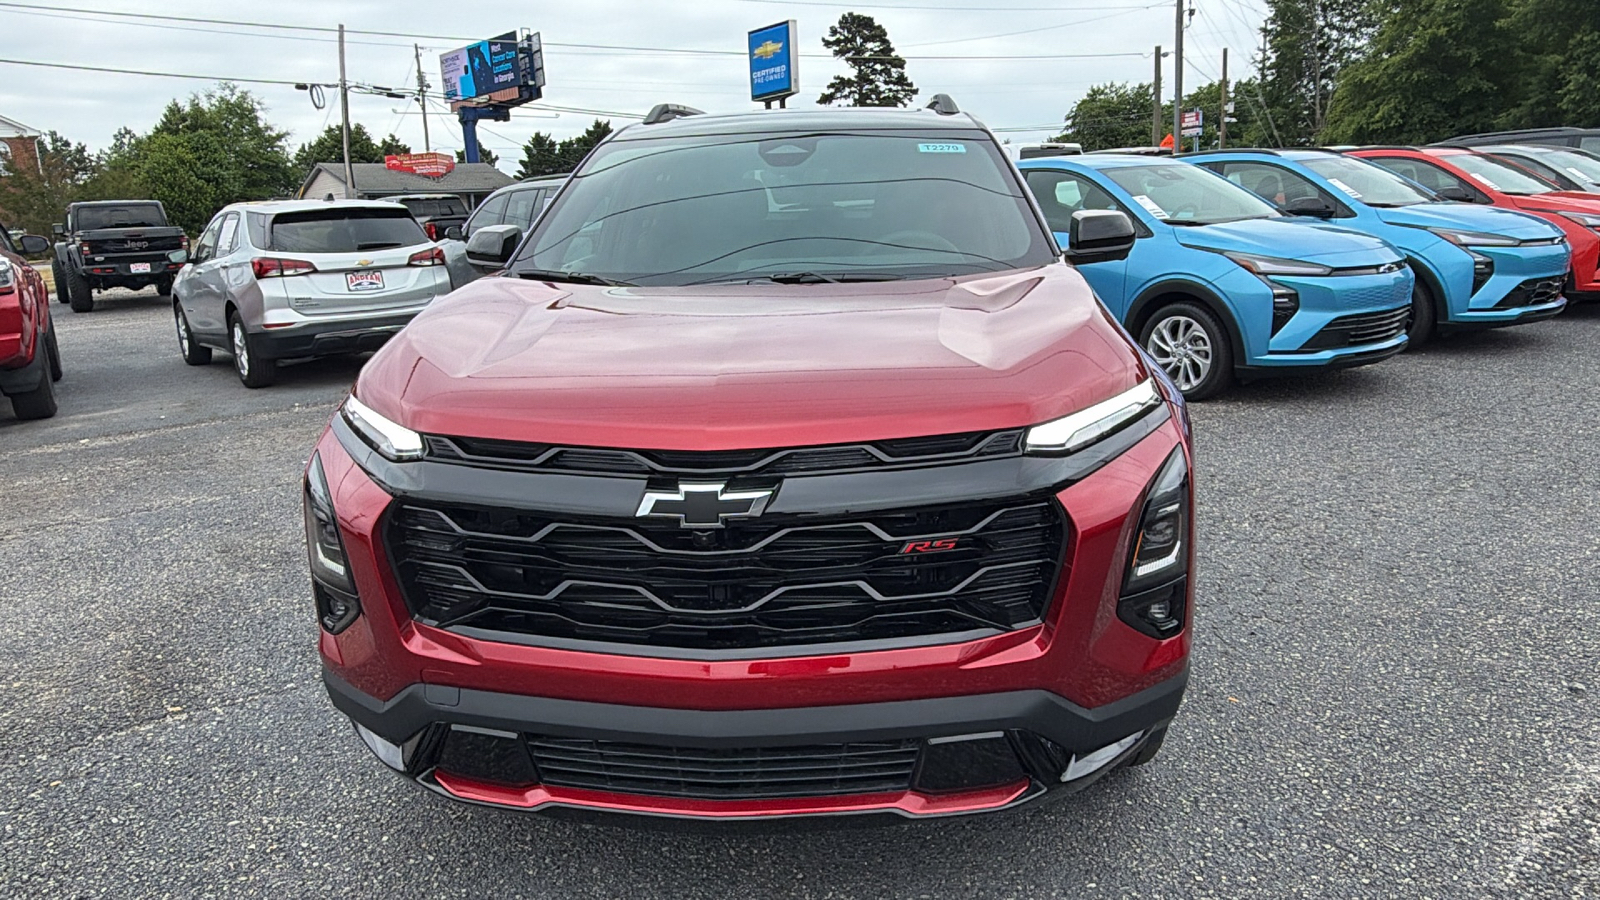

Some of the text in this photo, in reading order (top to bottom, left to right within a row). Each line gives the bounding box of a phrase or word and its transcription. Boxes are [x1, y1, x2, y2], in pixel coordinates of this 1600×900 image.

[492, 51, 516, 63] Cancer Care
[494, 71, 515, 84] in Georgia
[752, 64, 786, 79] CERTIFIED
[754, 71, 785, 85] PRE-OWNED
[124, 240, 149, 249] Jeep
[901, 537, 959, 554] RS
